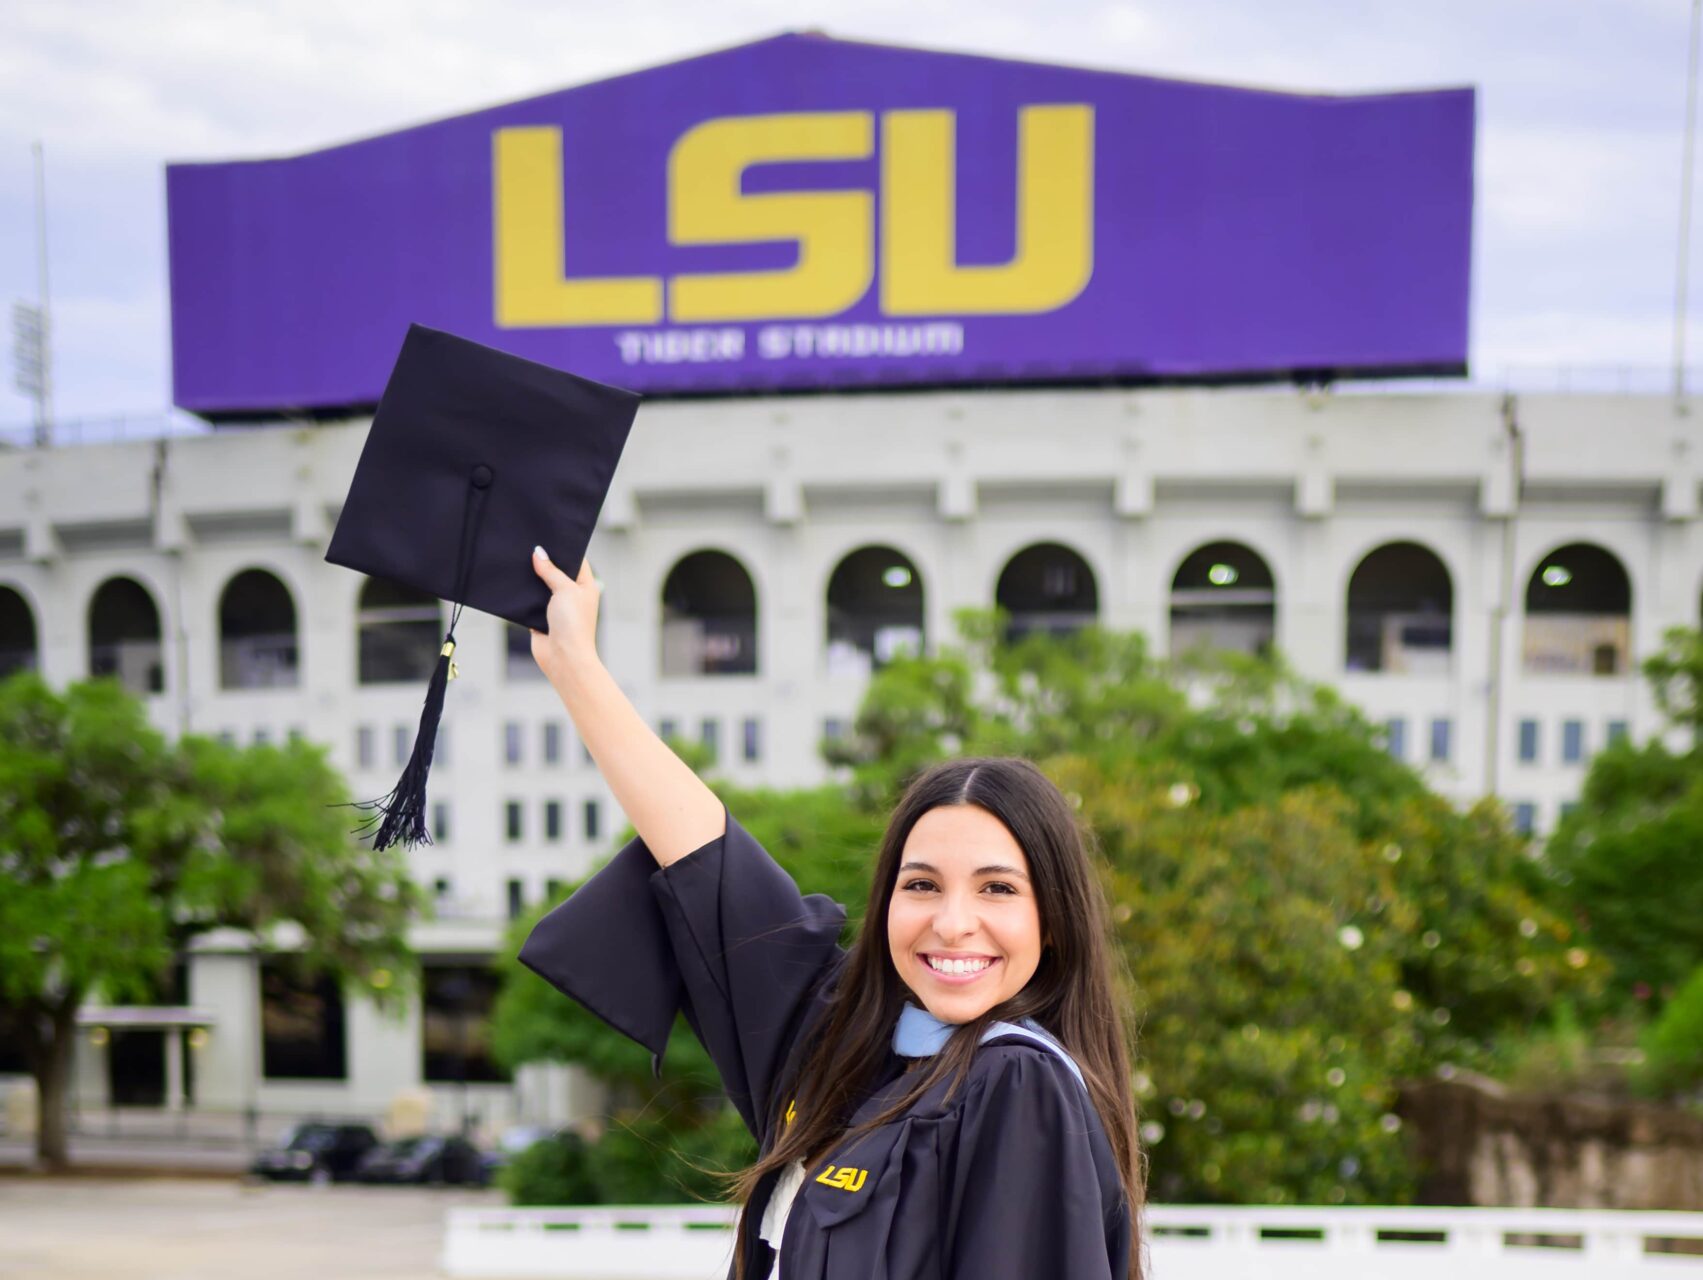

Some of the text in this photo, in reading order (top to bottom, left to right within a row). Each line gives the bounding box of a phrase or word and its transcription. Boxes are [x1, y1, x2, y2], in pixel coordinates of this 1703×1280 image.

[492, 104, 1094, 328] LSU
[616, 323, 965, 363] TIGER STADIUM
[816, 1165, 868, 1192] LSU
